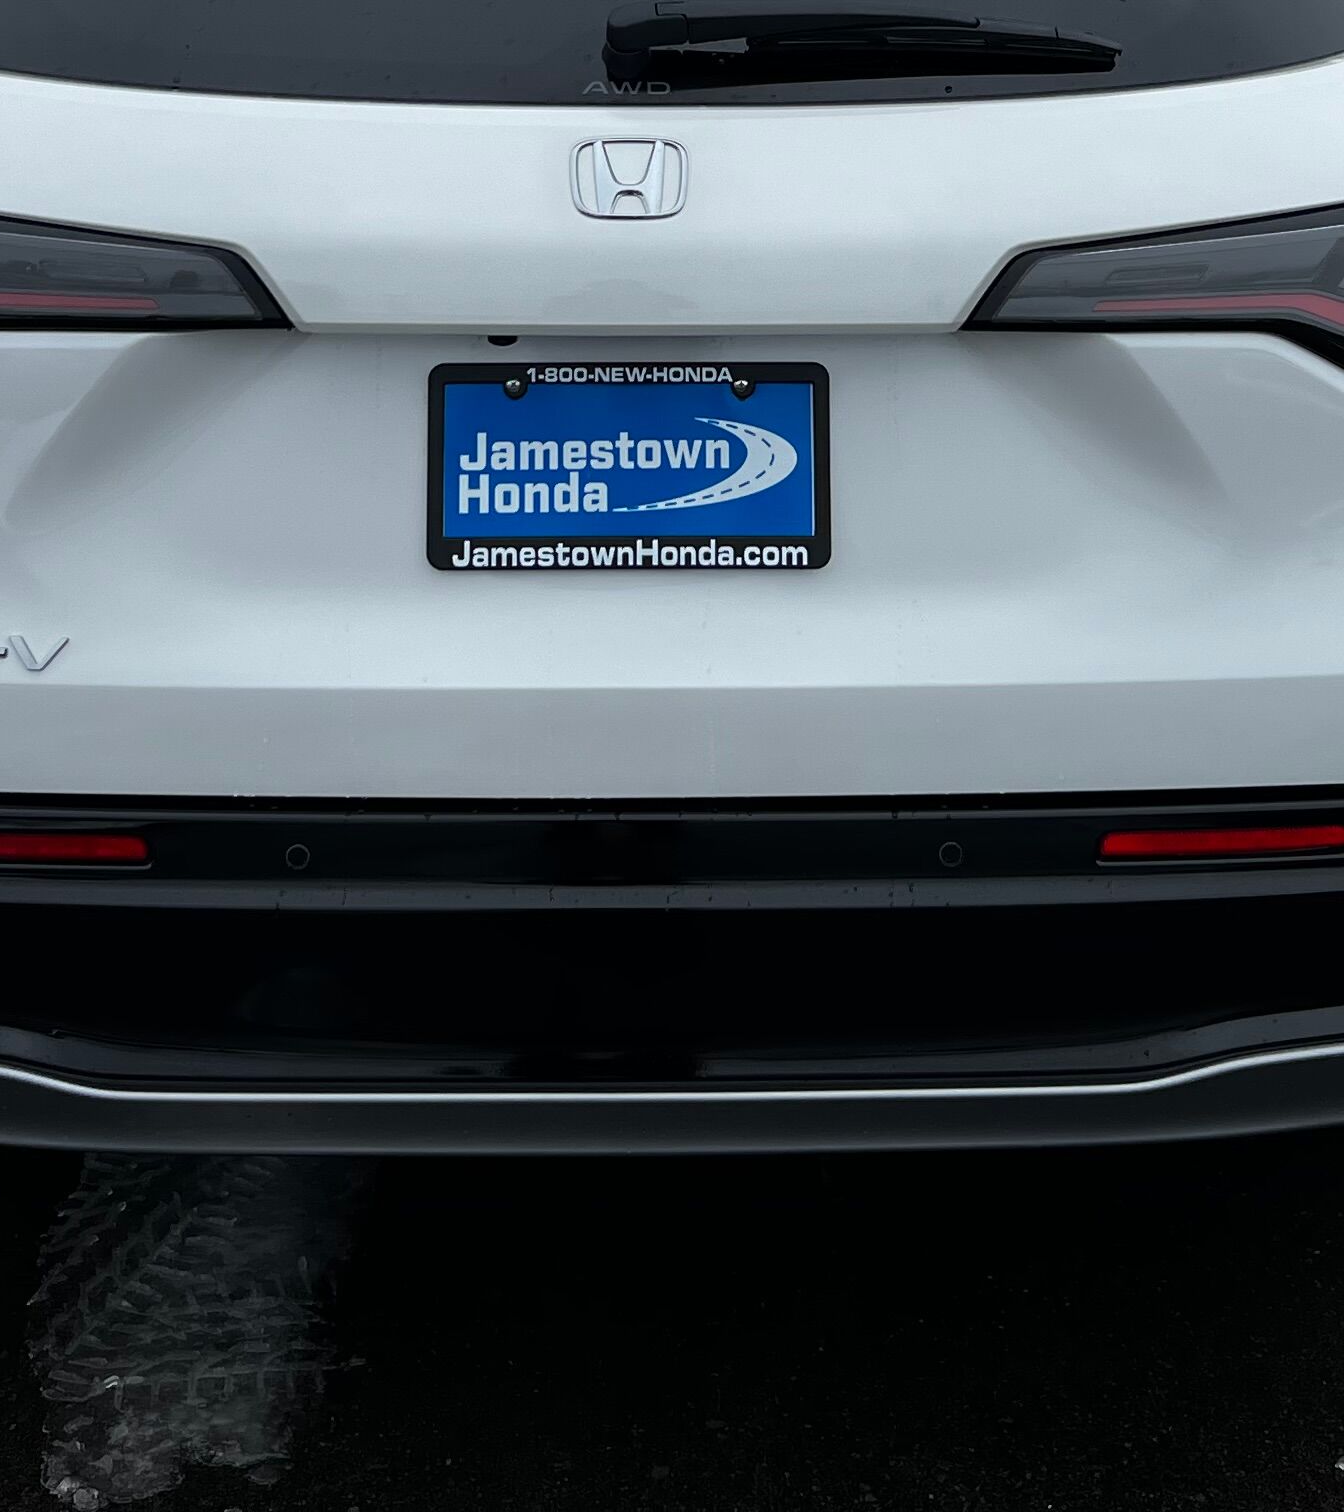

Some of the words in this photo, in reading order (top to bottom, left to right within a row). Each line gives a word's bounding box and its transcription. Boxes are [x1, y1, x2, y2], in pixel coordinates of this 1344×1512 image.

[582, 81, 671, 95] AWD
[527, 367, 733, 383] 1-800-NEW-HONDA
[460, 432, 730, 470] Jamestown
[459, 471, 608, 514] Honda
[452, 539, 808, 568] JamestownHonda.com
